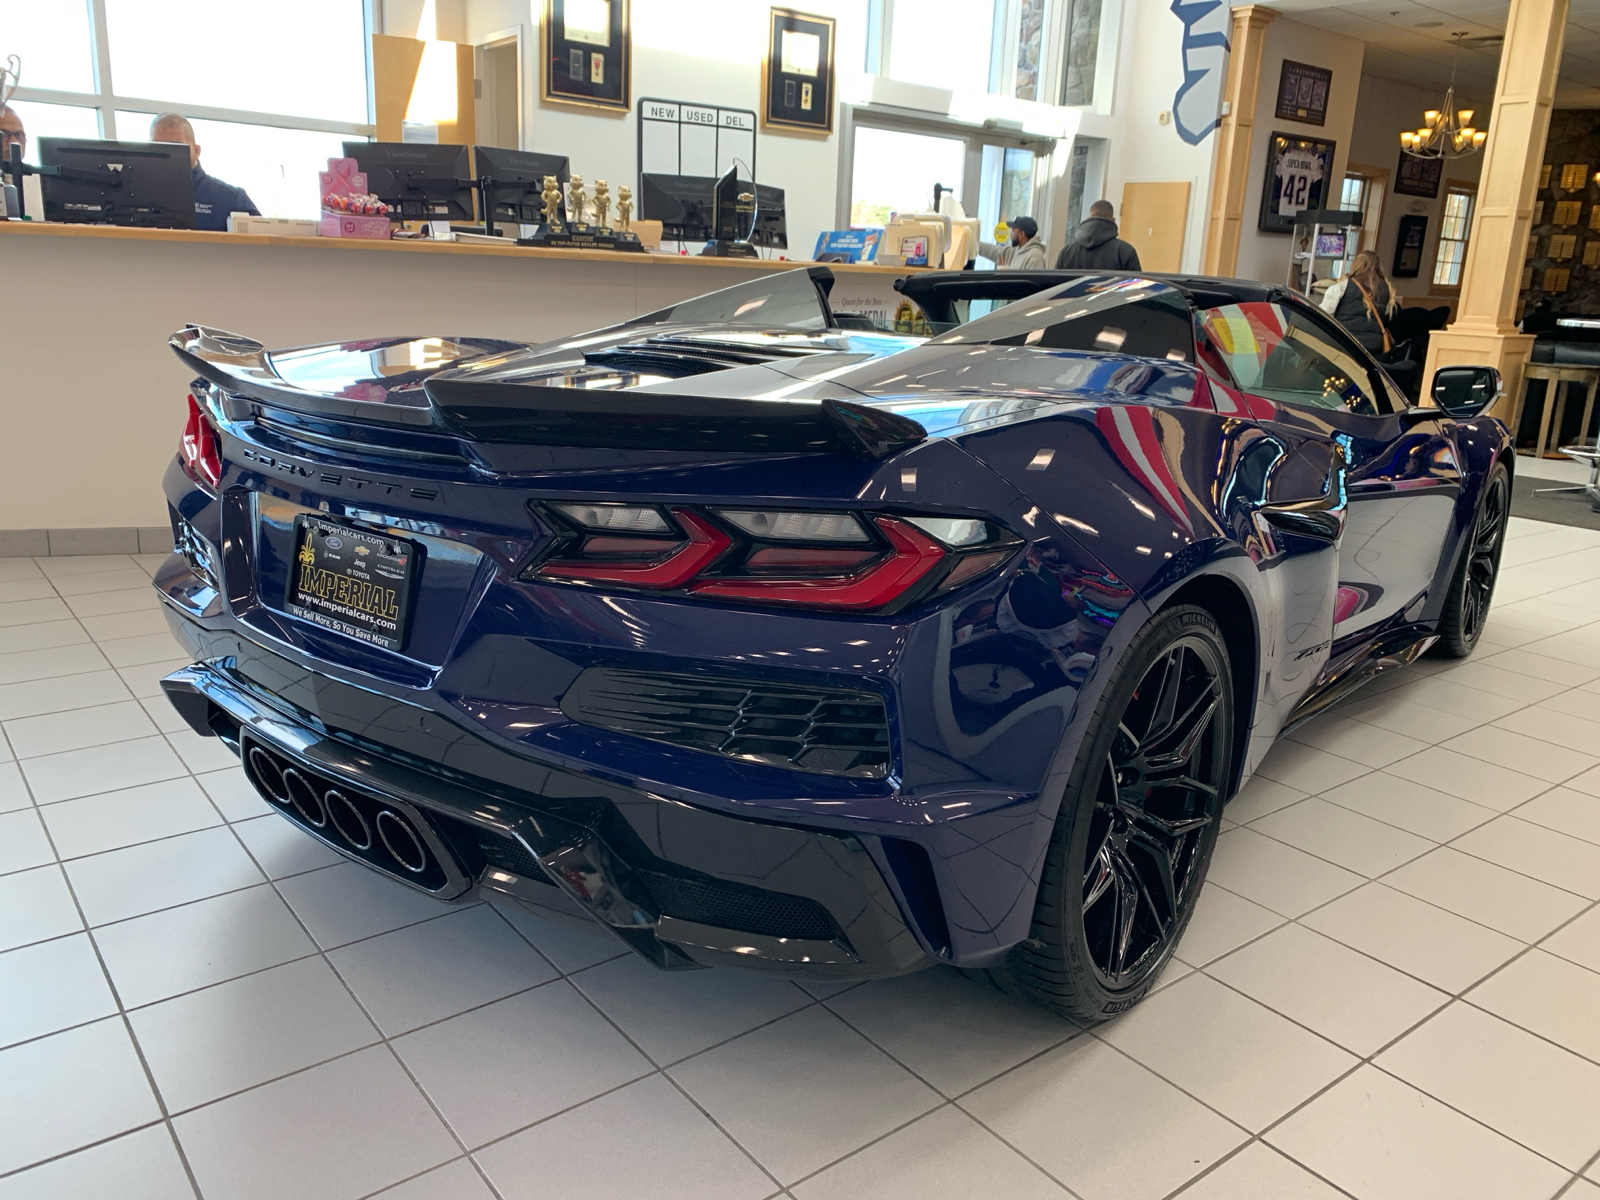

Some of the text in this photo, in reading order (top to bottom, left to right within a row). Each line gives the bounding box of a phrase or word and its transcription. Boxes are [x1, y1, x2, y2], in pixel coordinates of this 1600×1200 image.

[651, 106, 675, 118] NEW
[686, 110, 714, 123] USED
[725, 115, 745, 127] DEL
[386, 150, 428, 159] ViewSonic
[1283, 174, 1306, 205] 42
[841, 297, 883, 308] Quest for the Best
[243, 448, 439, 501] CORVETTE
[317, 520, 385, 547] Imperialcars.com
[354, 559, 366, 569] Jeep
[377, 563, 405, 574] CHRYSLER
[352, 569, 370, 581] TOYOTA
[299, 564, 399, 621] IMPERIAL
[298, 592, 397, 631] www.imperialcars.com
[293, 606, 389, 648] We Sell More, So You Save More
[1181, 612, 1217, 635] MICHELIN
